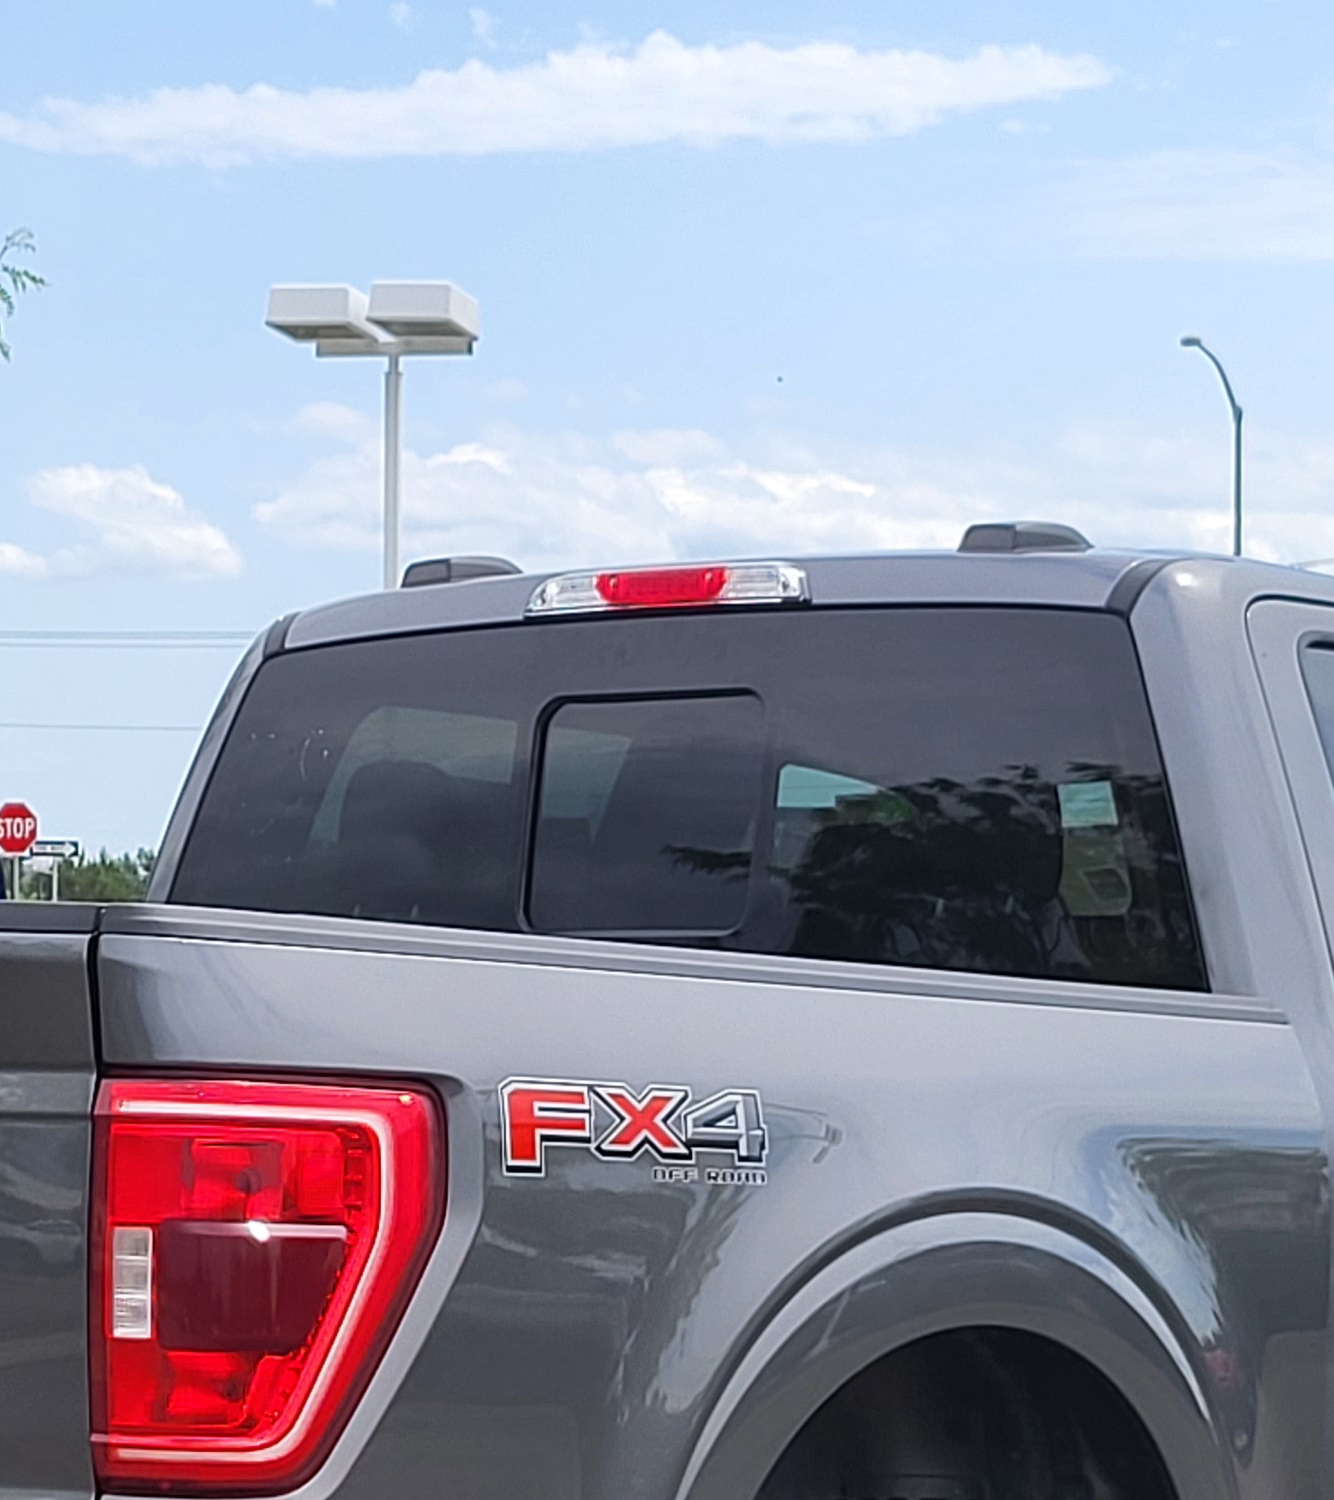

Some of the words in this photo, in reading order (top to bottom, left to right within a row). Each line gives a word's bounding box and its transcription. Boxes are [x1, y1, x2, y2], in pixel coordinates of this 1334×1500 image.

[499, 1077, 768, 1177] FX4
[653, 1166, 698, 1183] OFF
[706, 1168, 767, 1185] ROAD
